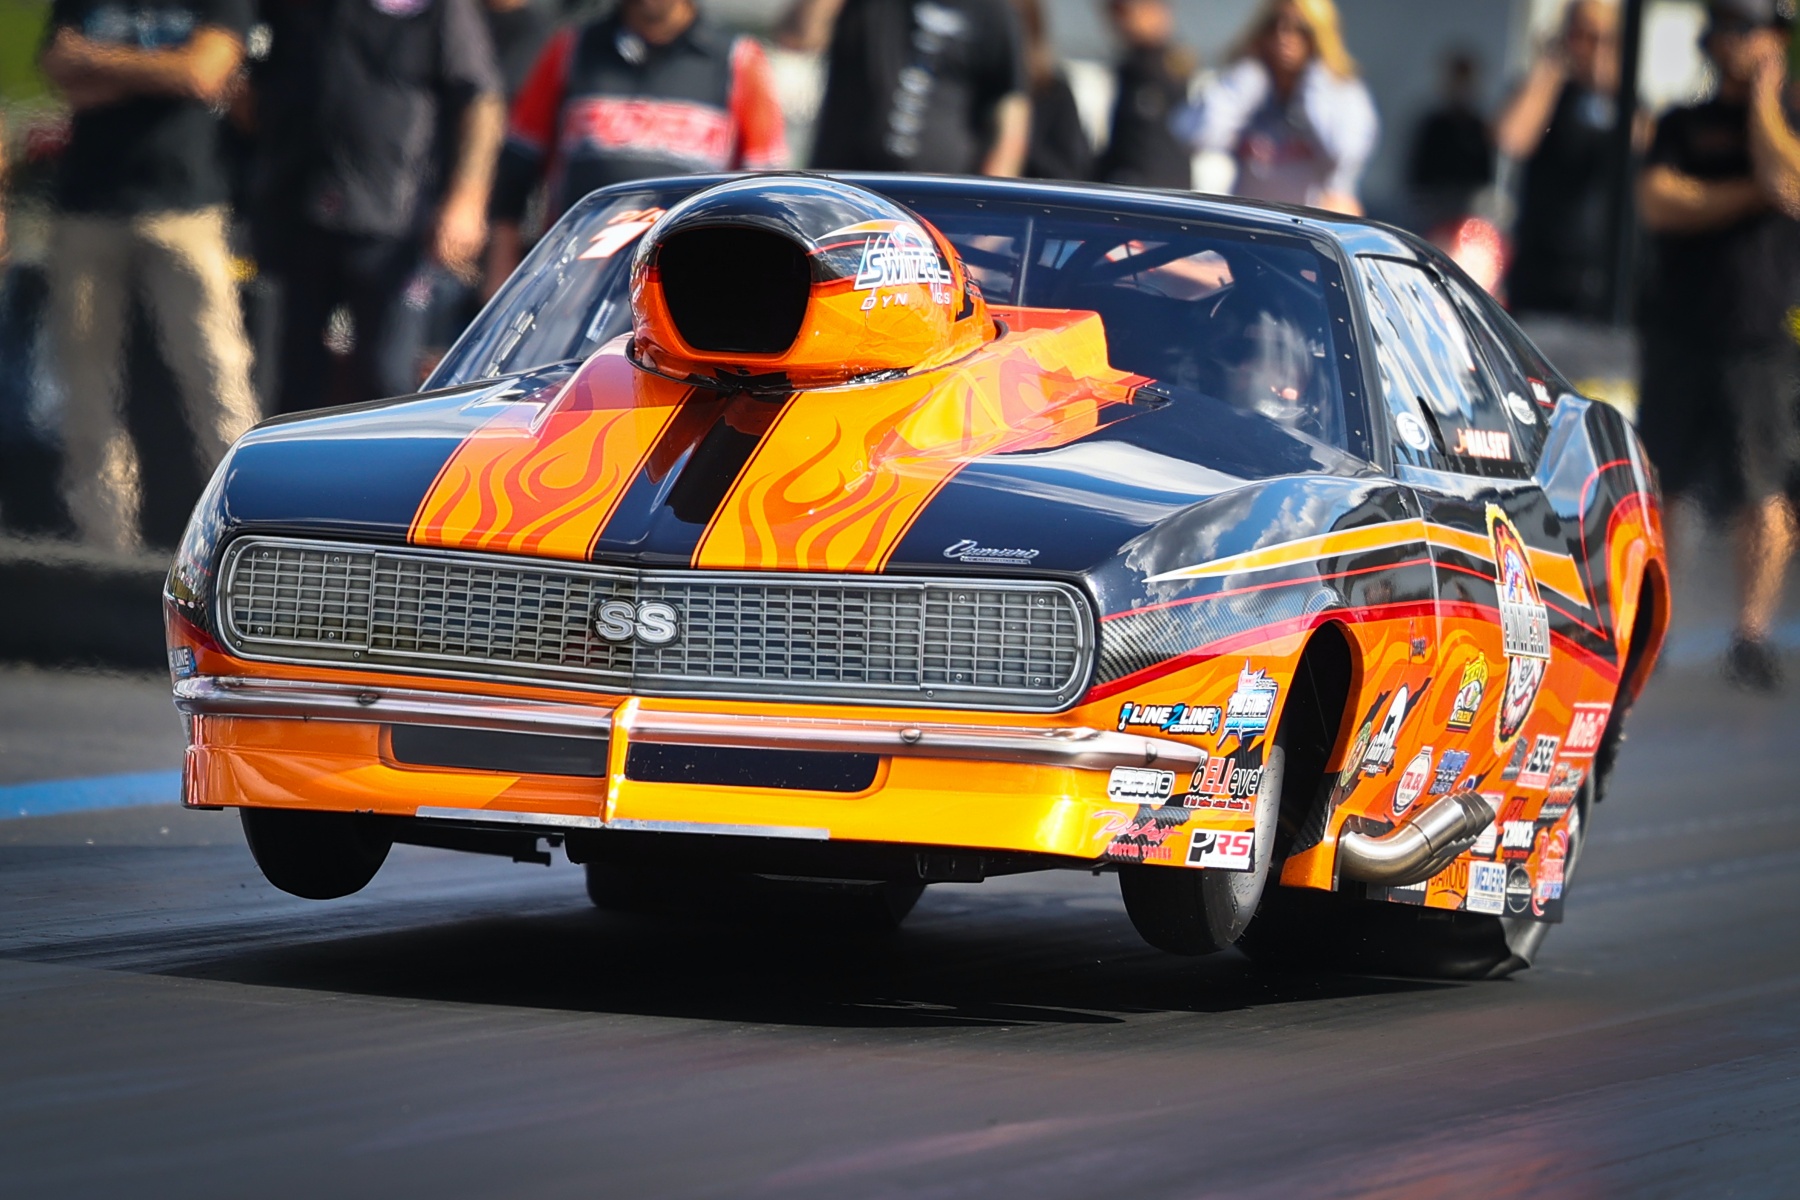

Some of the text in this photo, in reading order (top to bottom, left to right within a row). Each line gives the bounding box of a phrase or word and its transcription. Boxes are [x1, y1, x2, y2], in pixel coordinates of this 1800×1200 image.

[943, 539, 1040, 559] Camaro
[596, 599, 677, 643] SS
[1189, 832, 1251, 862] PRS
